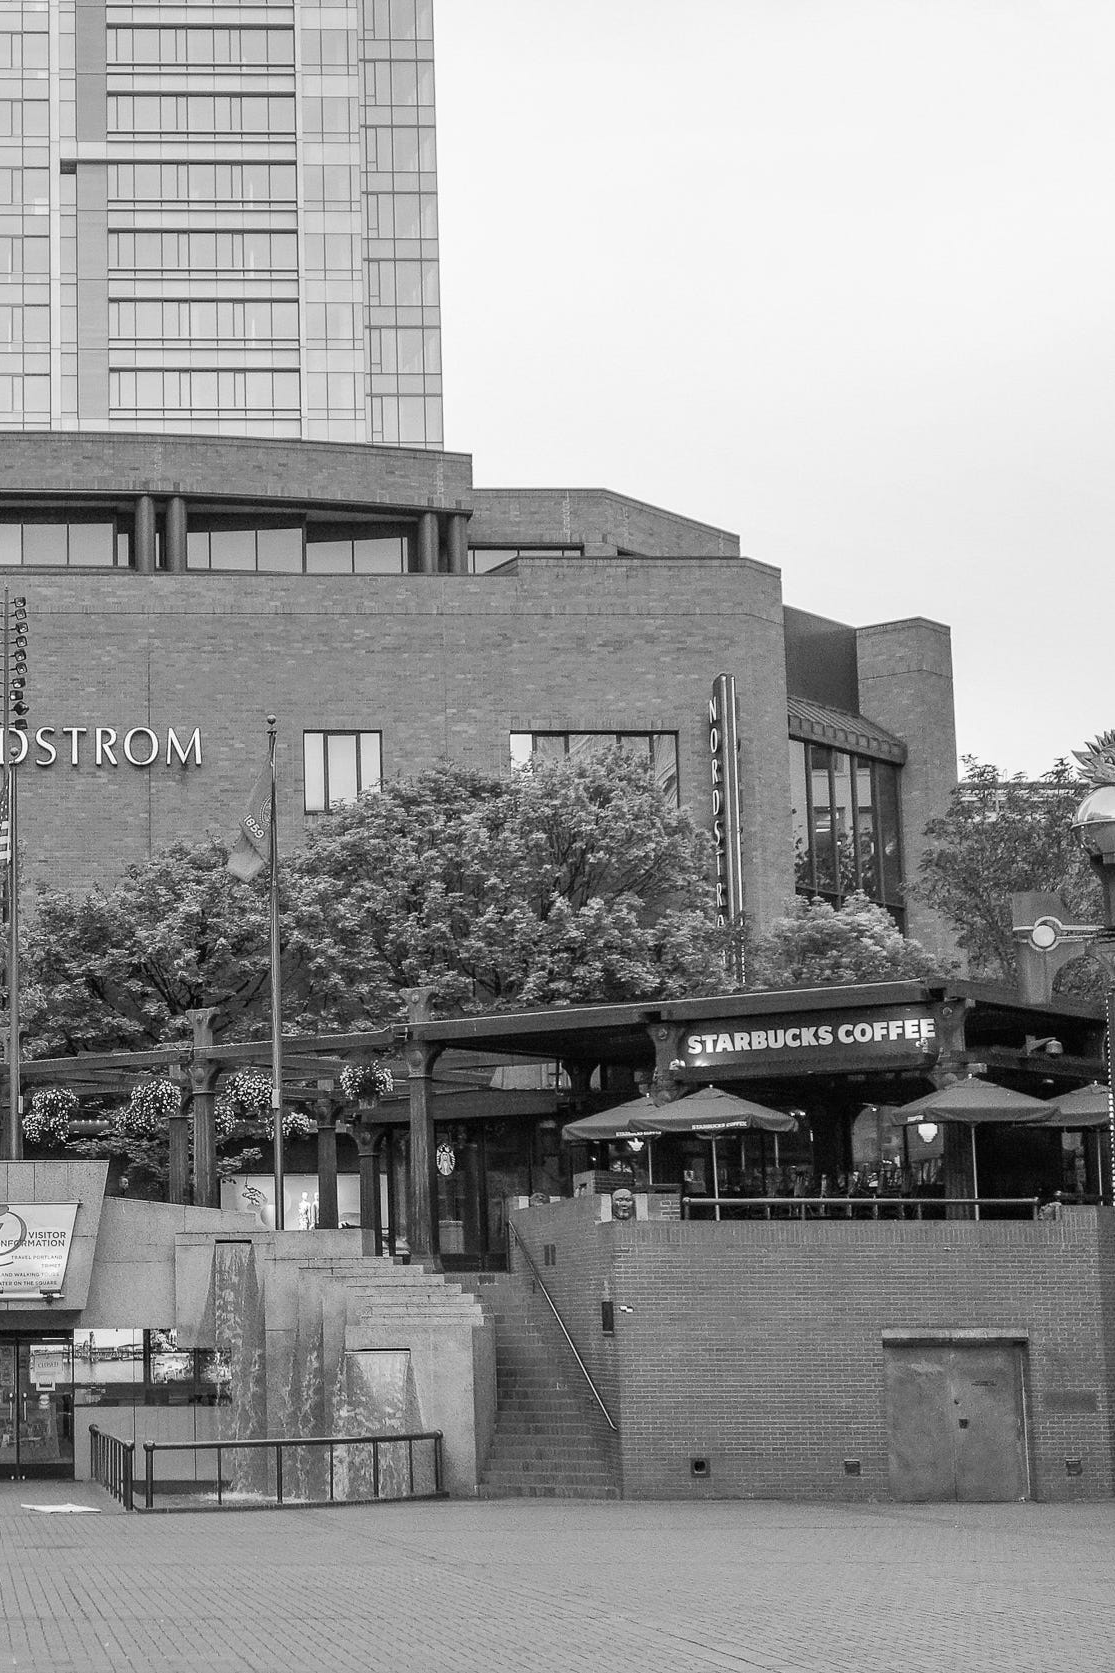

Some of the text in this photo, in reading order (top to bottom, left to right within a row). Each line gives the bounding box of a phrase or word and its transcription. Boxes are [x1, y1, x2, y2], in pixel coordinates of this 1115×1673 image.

[244, 814, 265, 838] 1859
[709, 697, 725, 965] NORDSTRO
[687, 1018, 935, 1054] STARBUCKS COFFEE
[28, 1231, 66, 1239] VISITOR
